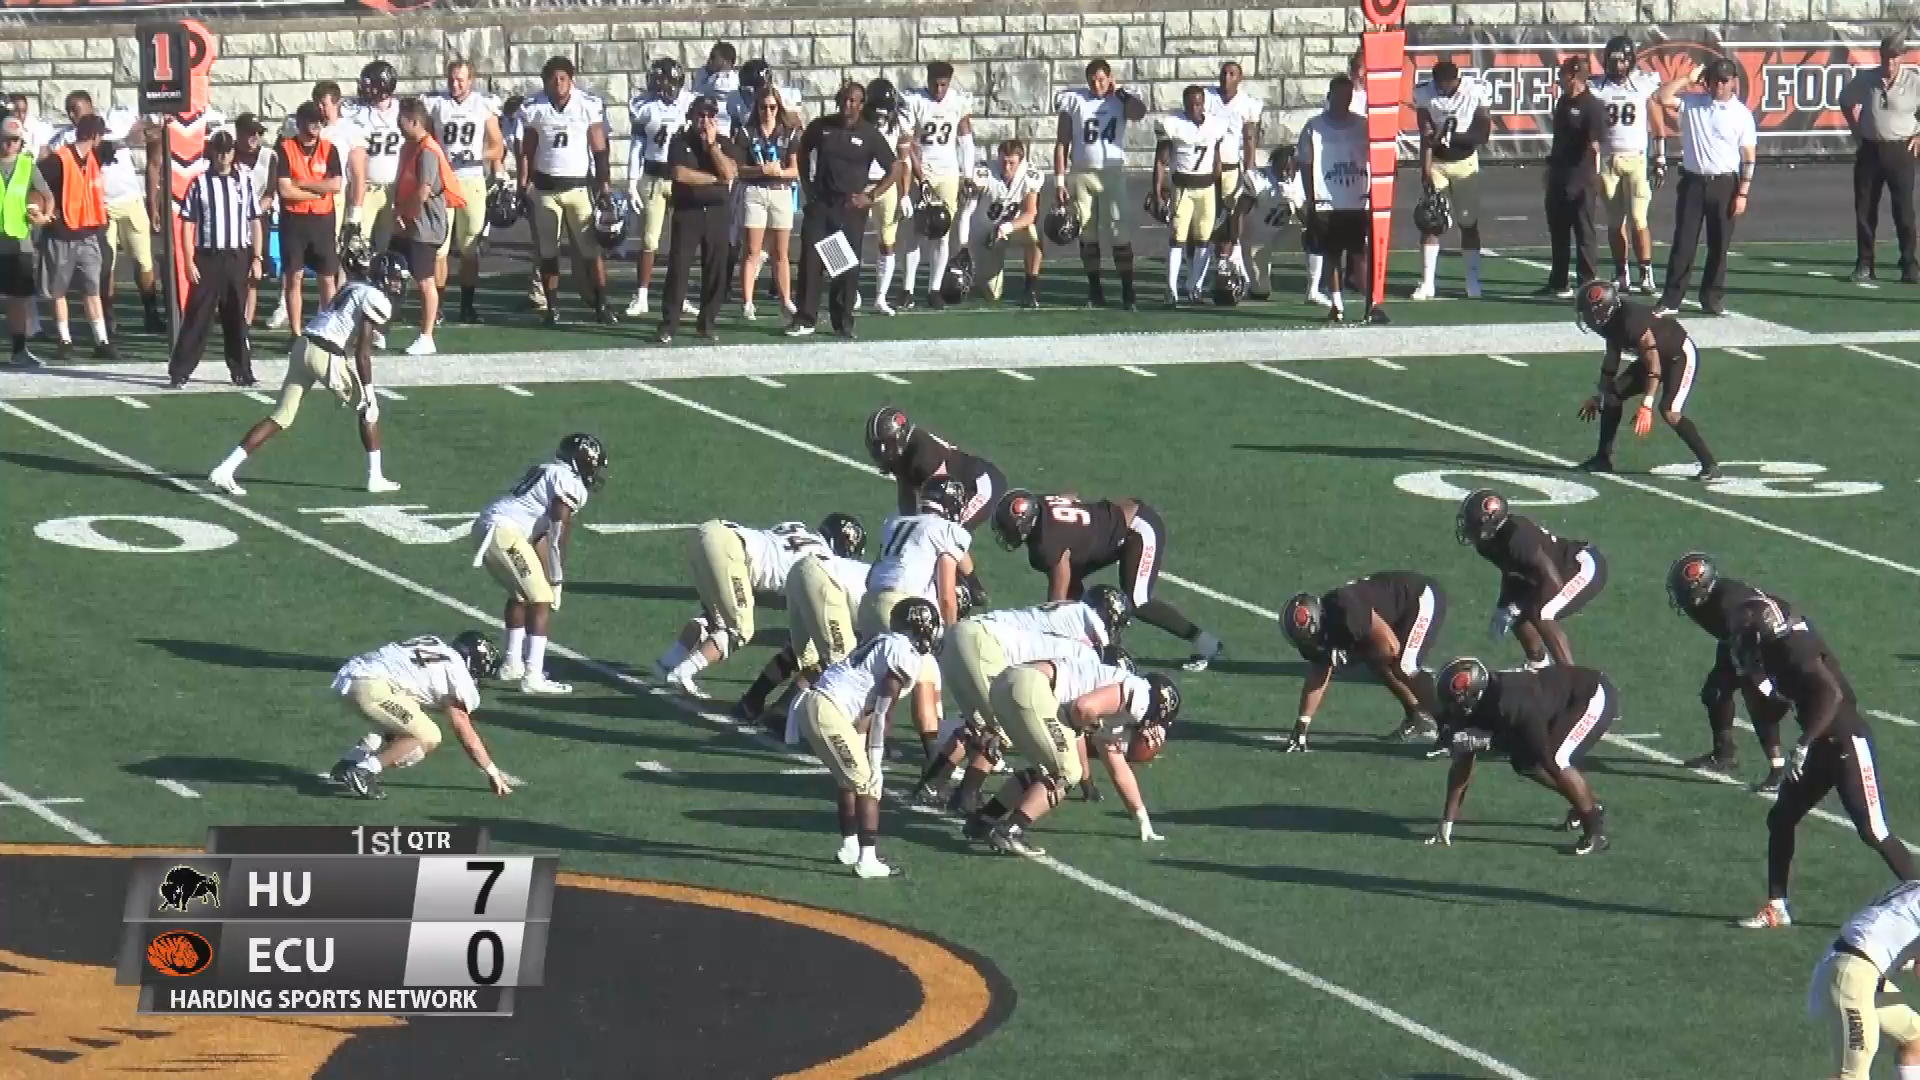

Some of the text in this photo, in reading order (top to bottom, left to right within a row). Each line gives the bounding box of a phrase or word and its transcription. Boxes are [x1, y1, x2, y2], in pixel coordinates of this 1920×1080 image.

[151, 33, 173, 81] 1
[443, 121, 476, 147] 89
[920, 121, 953, 146] 23
[1083, 117, 1118, 144] 64
[1192, 145, 1208, 172] 7
[883, 521, 920, 556] 11
